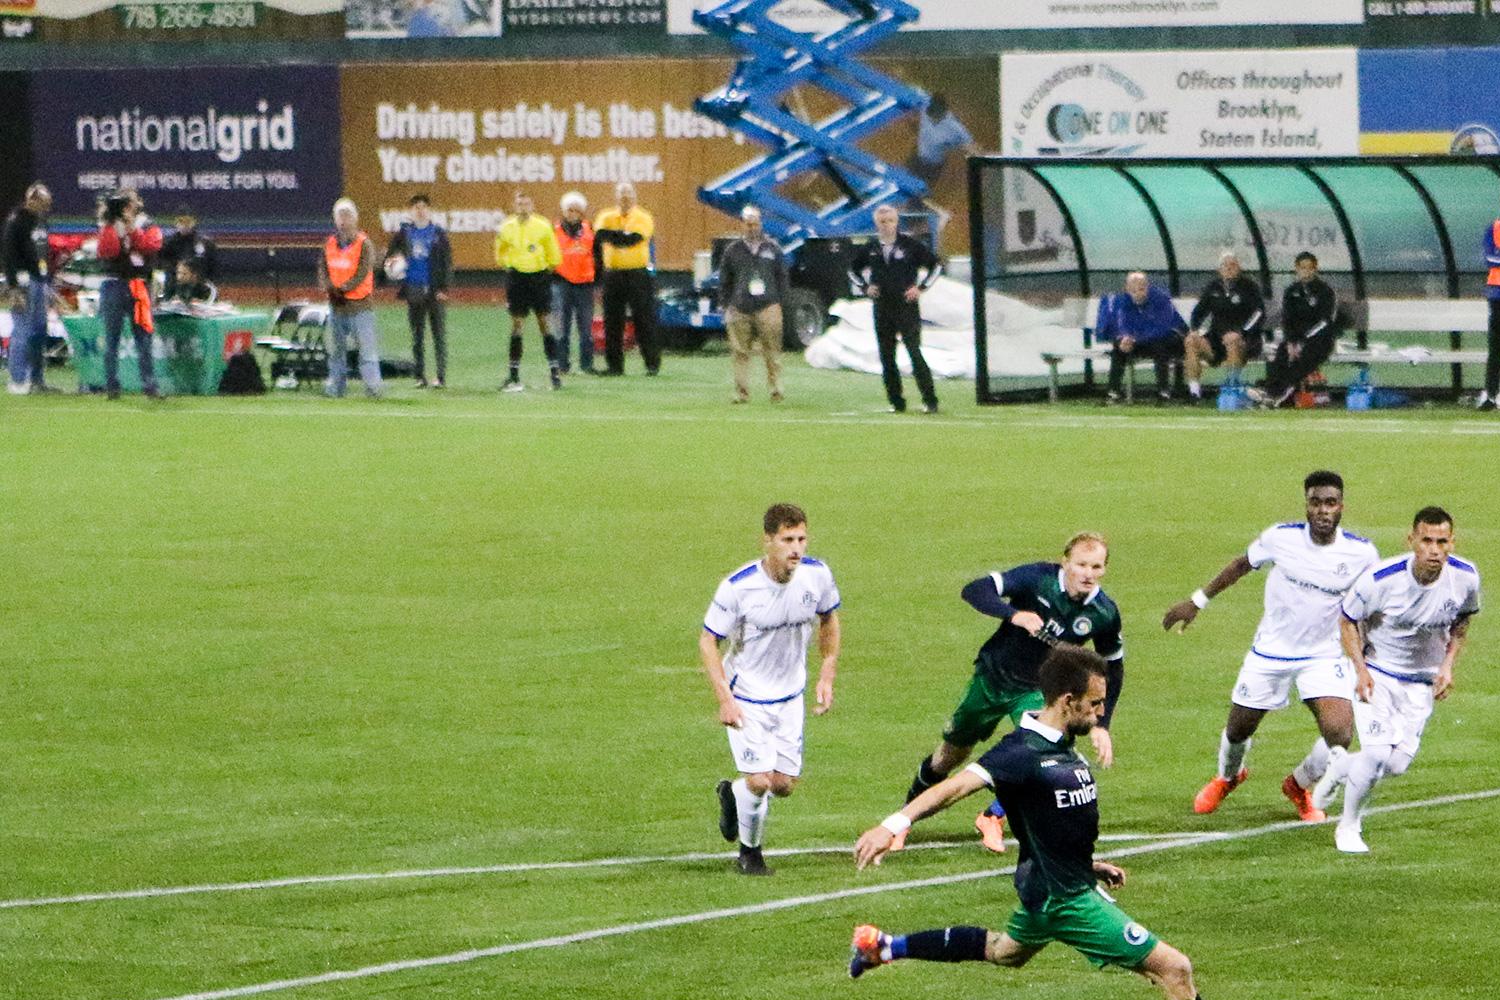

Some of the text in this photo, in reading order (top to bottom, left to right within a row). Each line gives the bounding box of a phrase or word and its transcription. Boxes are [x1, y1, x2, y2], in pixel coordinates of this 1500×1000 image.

[1176, 70, 1343, 94] Offices throughout
[1135, 111, 1168, 134] ONE
[1216, 101, 1301, 123] Brooklyn,
[76, 100, 296, 162] nationalgrid
[377, 103, 476, 146] Driving
[480, 102, 568, 145] safely
[574, 103, 603, 138] is
[608, 104, 657, 138] the
[1199, 127, 1322, 150] Staten Island,
[378, 148, 665, 183] Your choices matter.
[1335, 664, 1345, 679] 3
